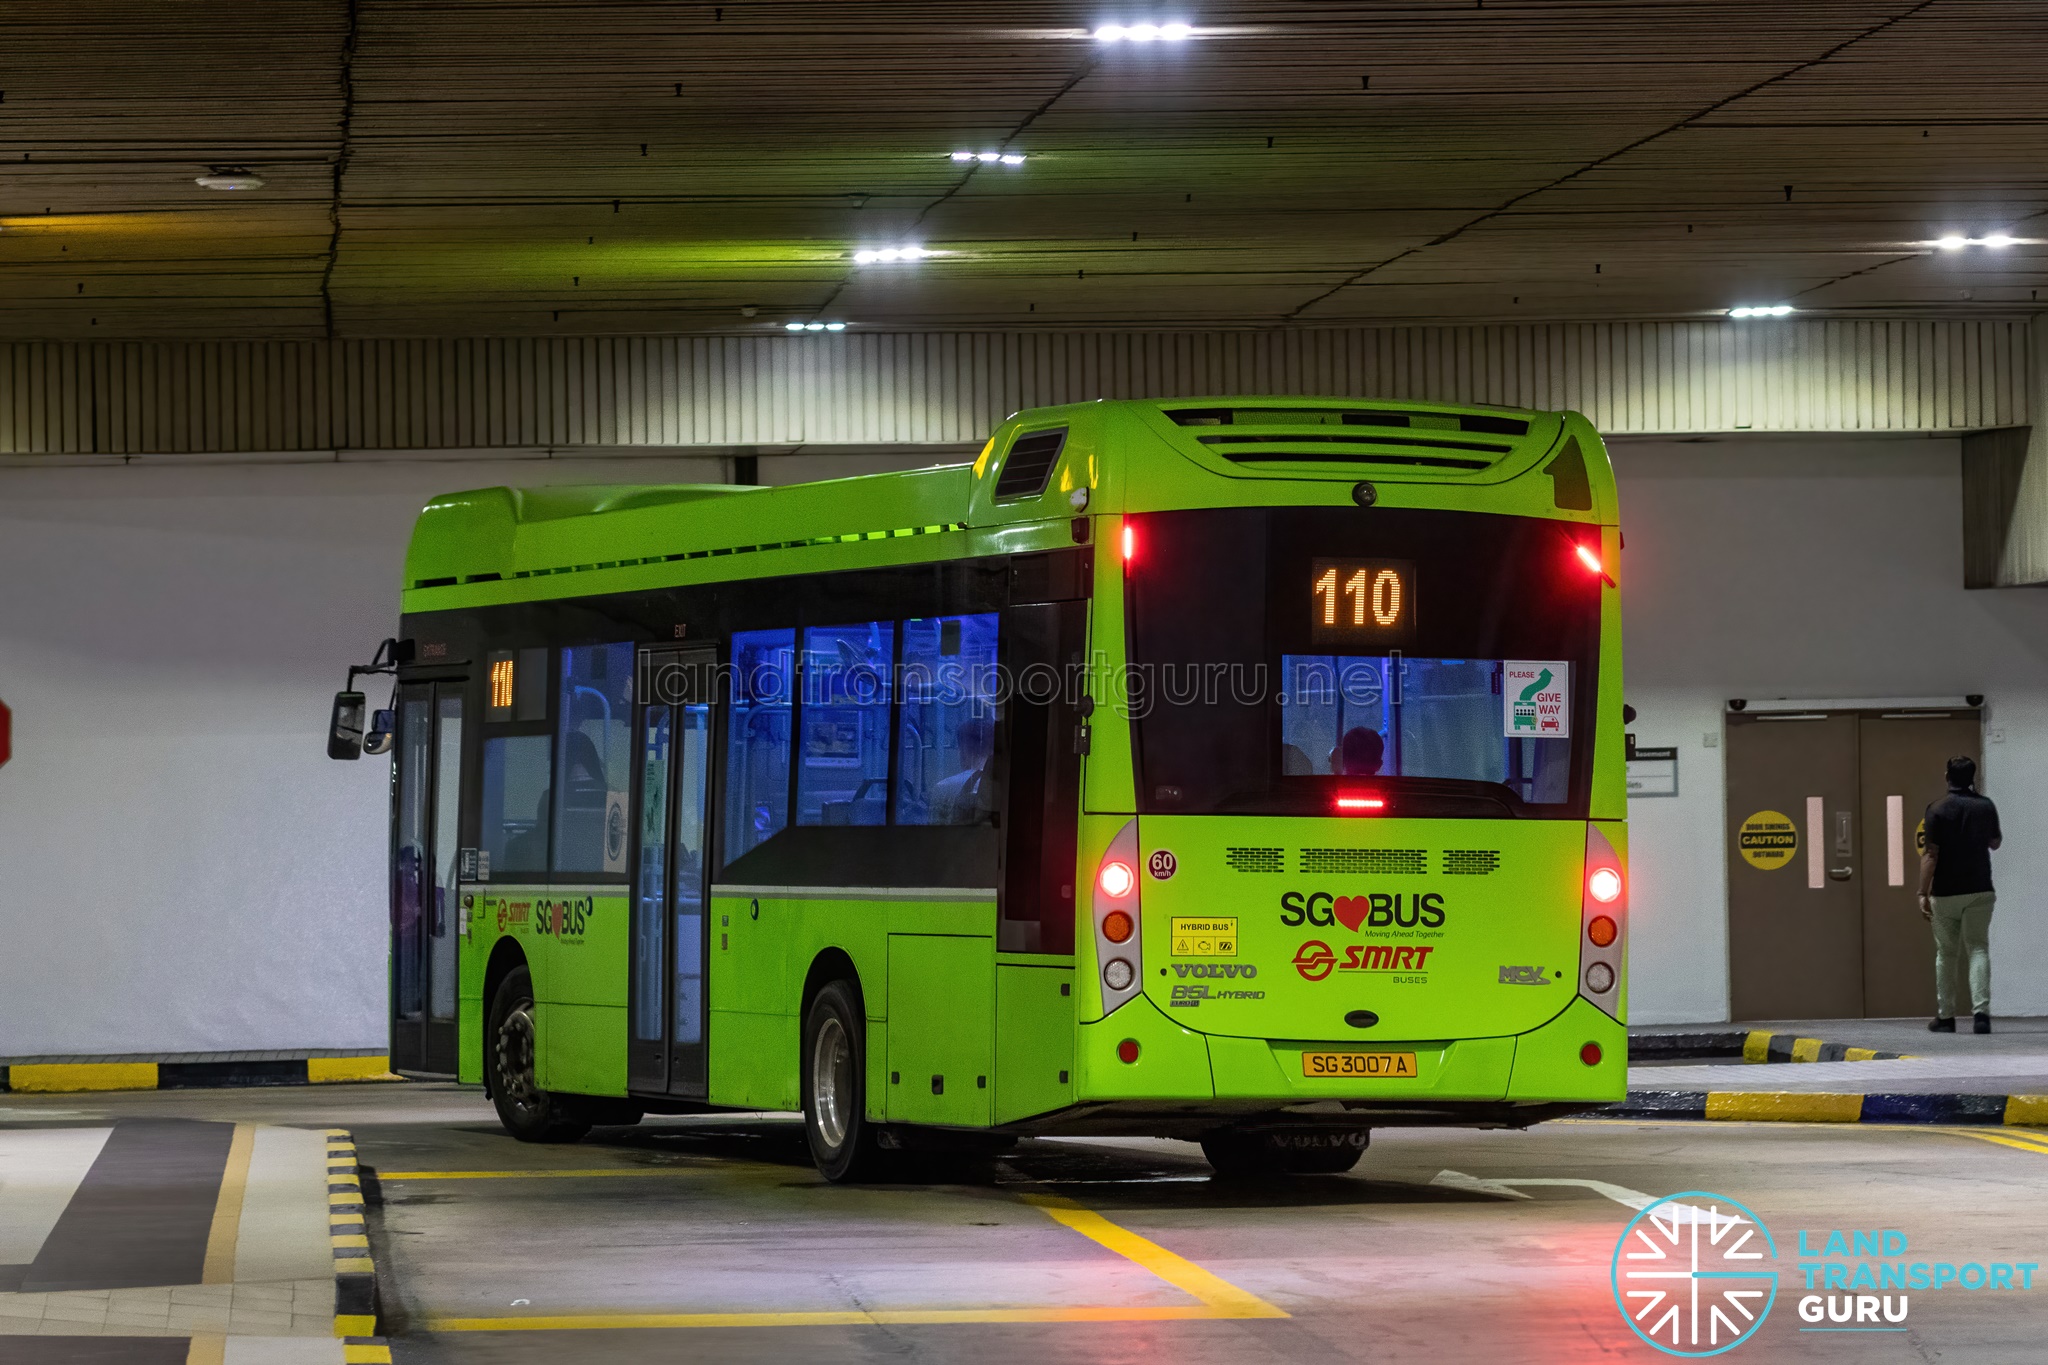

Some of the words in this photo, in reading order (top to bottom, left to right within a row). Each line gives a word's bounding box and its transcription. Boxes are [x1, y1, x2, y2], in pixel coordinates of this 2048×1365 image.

[1316, 569, 1400, 624] 110
[675, 623, 686, 638] EXIT
[1509, 671, 1535, 679] PLEASE
[491, 661, 513, 707] 110
[1537, 693, 1561, 702] GIVE
[1539, 705, 1561, 714] WAY
[1742, 835, 1794, 845] CAUTION
[1151, 854, 1173, 870] 60
[1154, 870, 1171, 878] km/h
[1365, 931, 1389, 939] Moving
[1416, 931, 1445, 939] Together
[1338, 946, 1434, 970] SMRT
[1171, 964, 1258, 979] VOLVO
[1499, 965, 1545, 983] MCV
[1393, 976, 1428, 984] BUSES
[1217, 991, 1266, 1000] HYBRID
